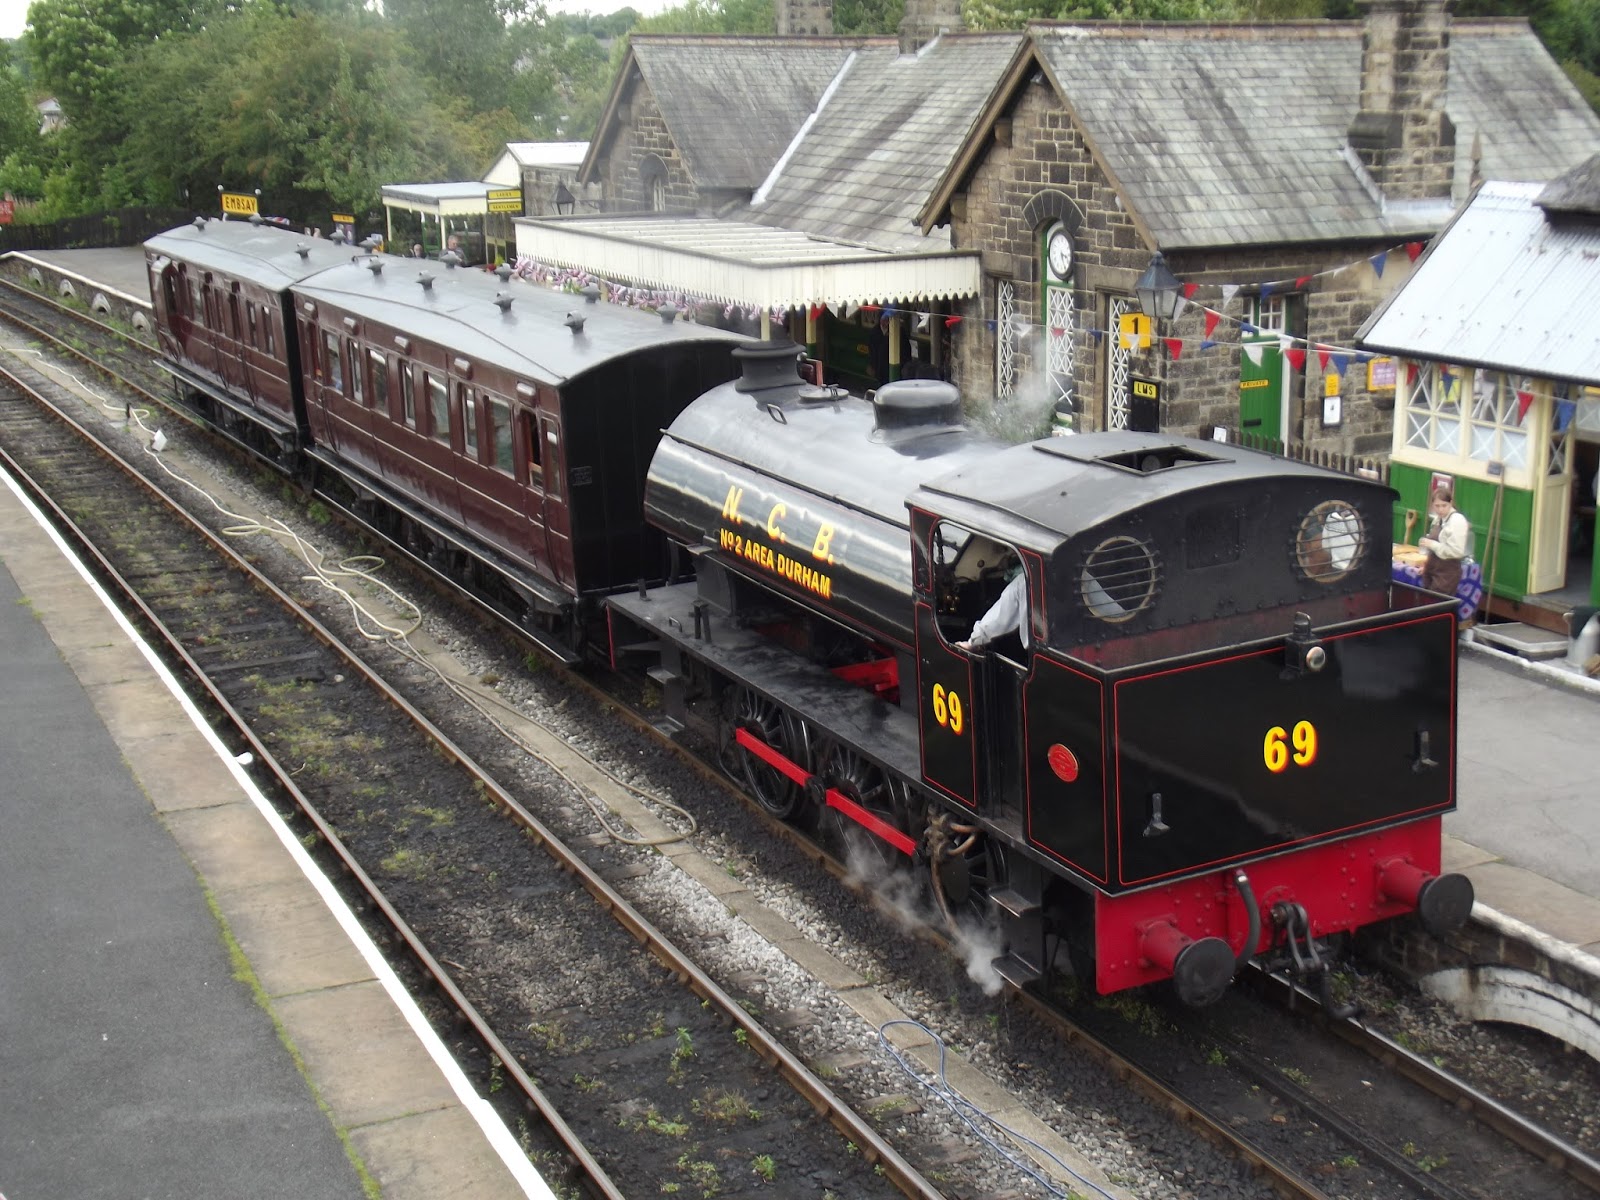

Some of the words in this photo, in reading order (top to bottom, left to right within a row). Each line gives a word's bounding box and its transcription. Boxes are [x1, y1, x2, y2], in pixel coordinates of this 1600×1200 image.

[224, 196, 256, 212] EMBSAY
[1132, 316, 1139, 335] 1
[744, 539, 775, 572] AREA
[777, 553, 832, 599] DURHAM
[932, 683, 963, 736] 69
[1263, 720, 1318, 773] 69
